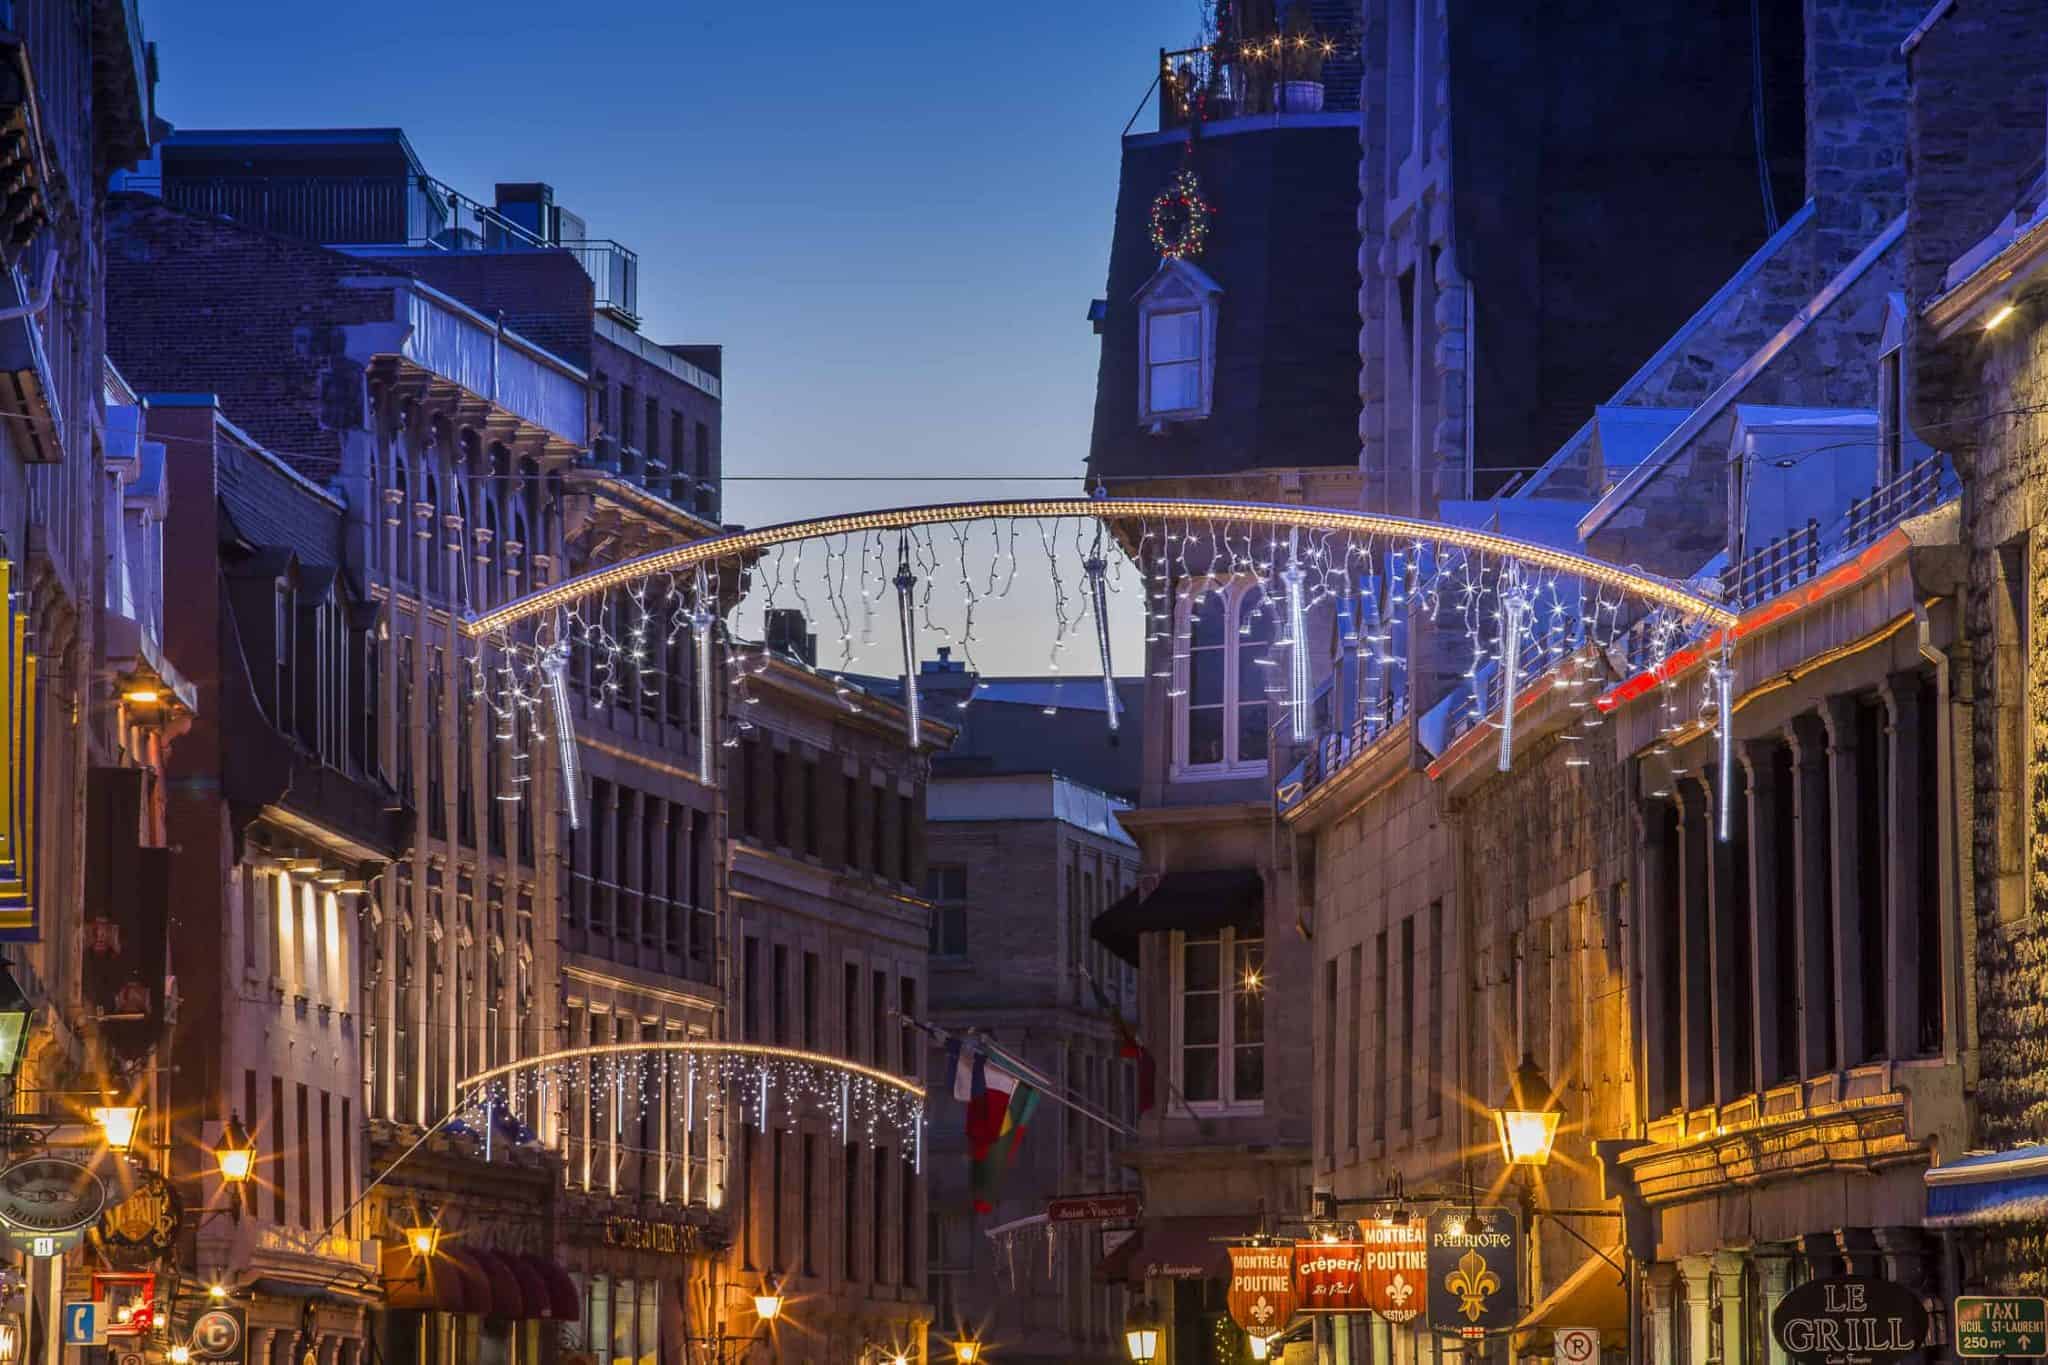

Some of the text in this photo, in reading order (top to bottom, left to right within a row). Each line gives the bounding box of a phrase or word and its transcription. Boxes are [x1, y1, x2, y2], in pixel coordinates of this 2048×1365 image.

[1233, 1253, 1289, 1269] MONTRÉAL
[1367, 1251, 1427, 1270] POUTINE
[1234, 1275, 1289, 1292] POUTINE
[1824, 1284, 1868, 1313] LE
[1984, 1302, 2019, 1320] TAXI
[1783, 1317, 1915, 1352] GRILL
[1963, 1336, 1988, 1349] 250
